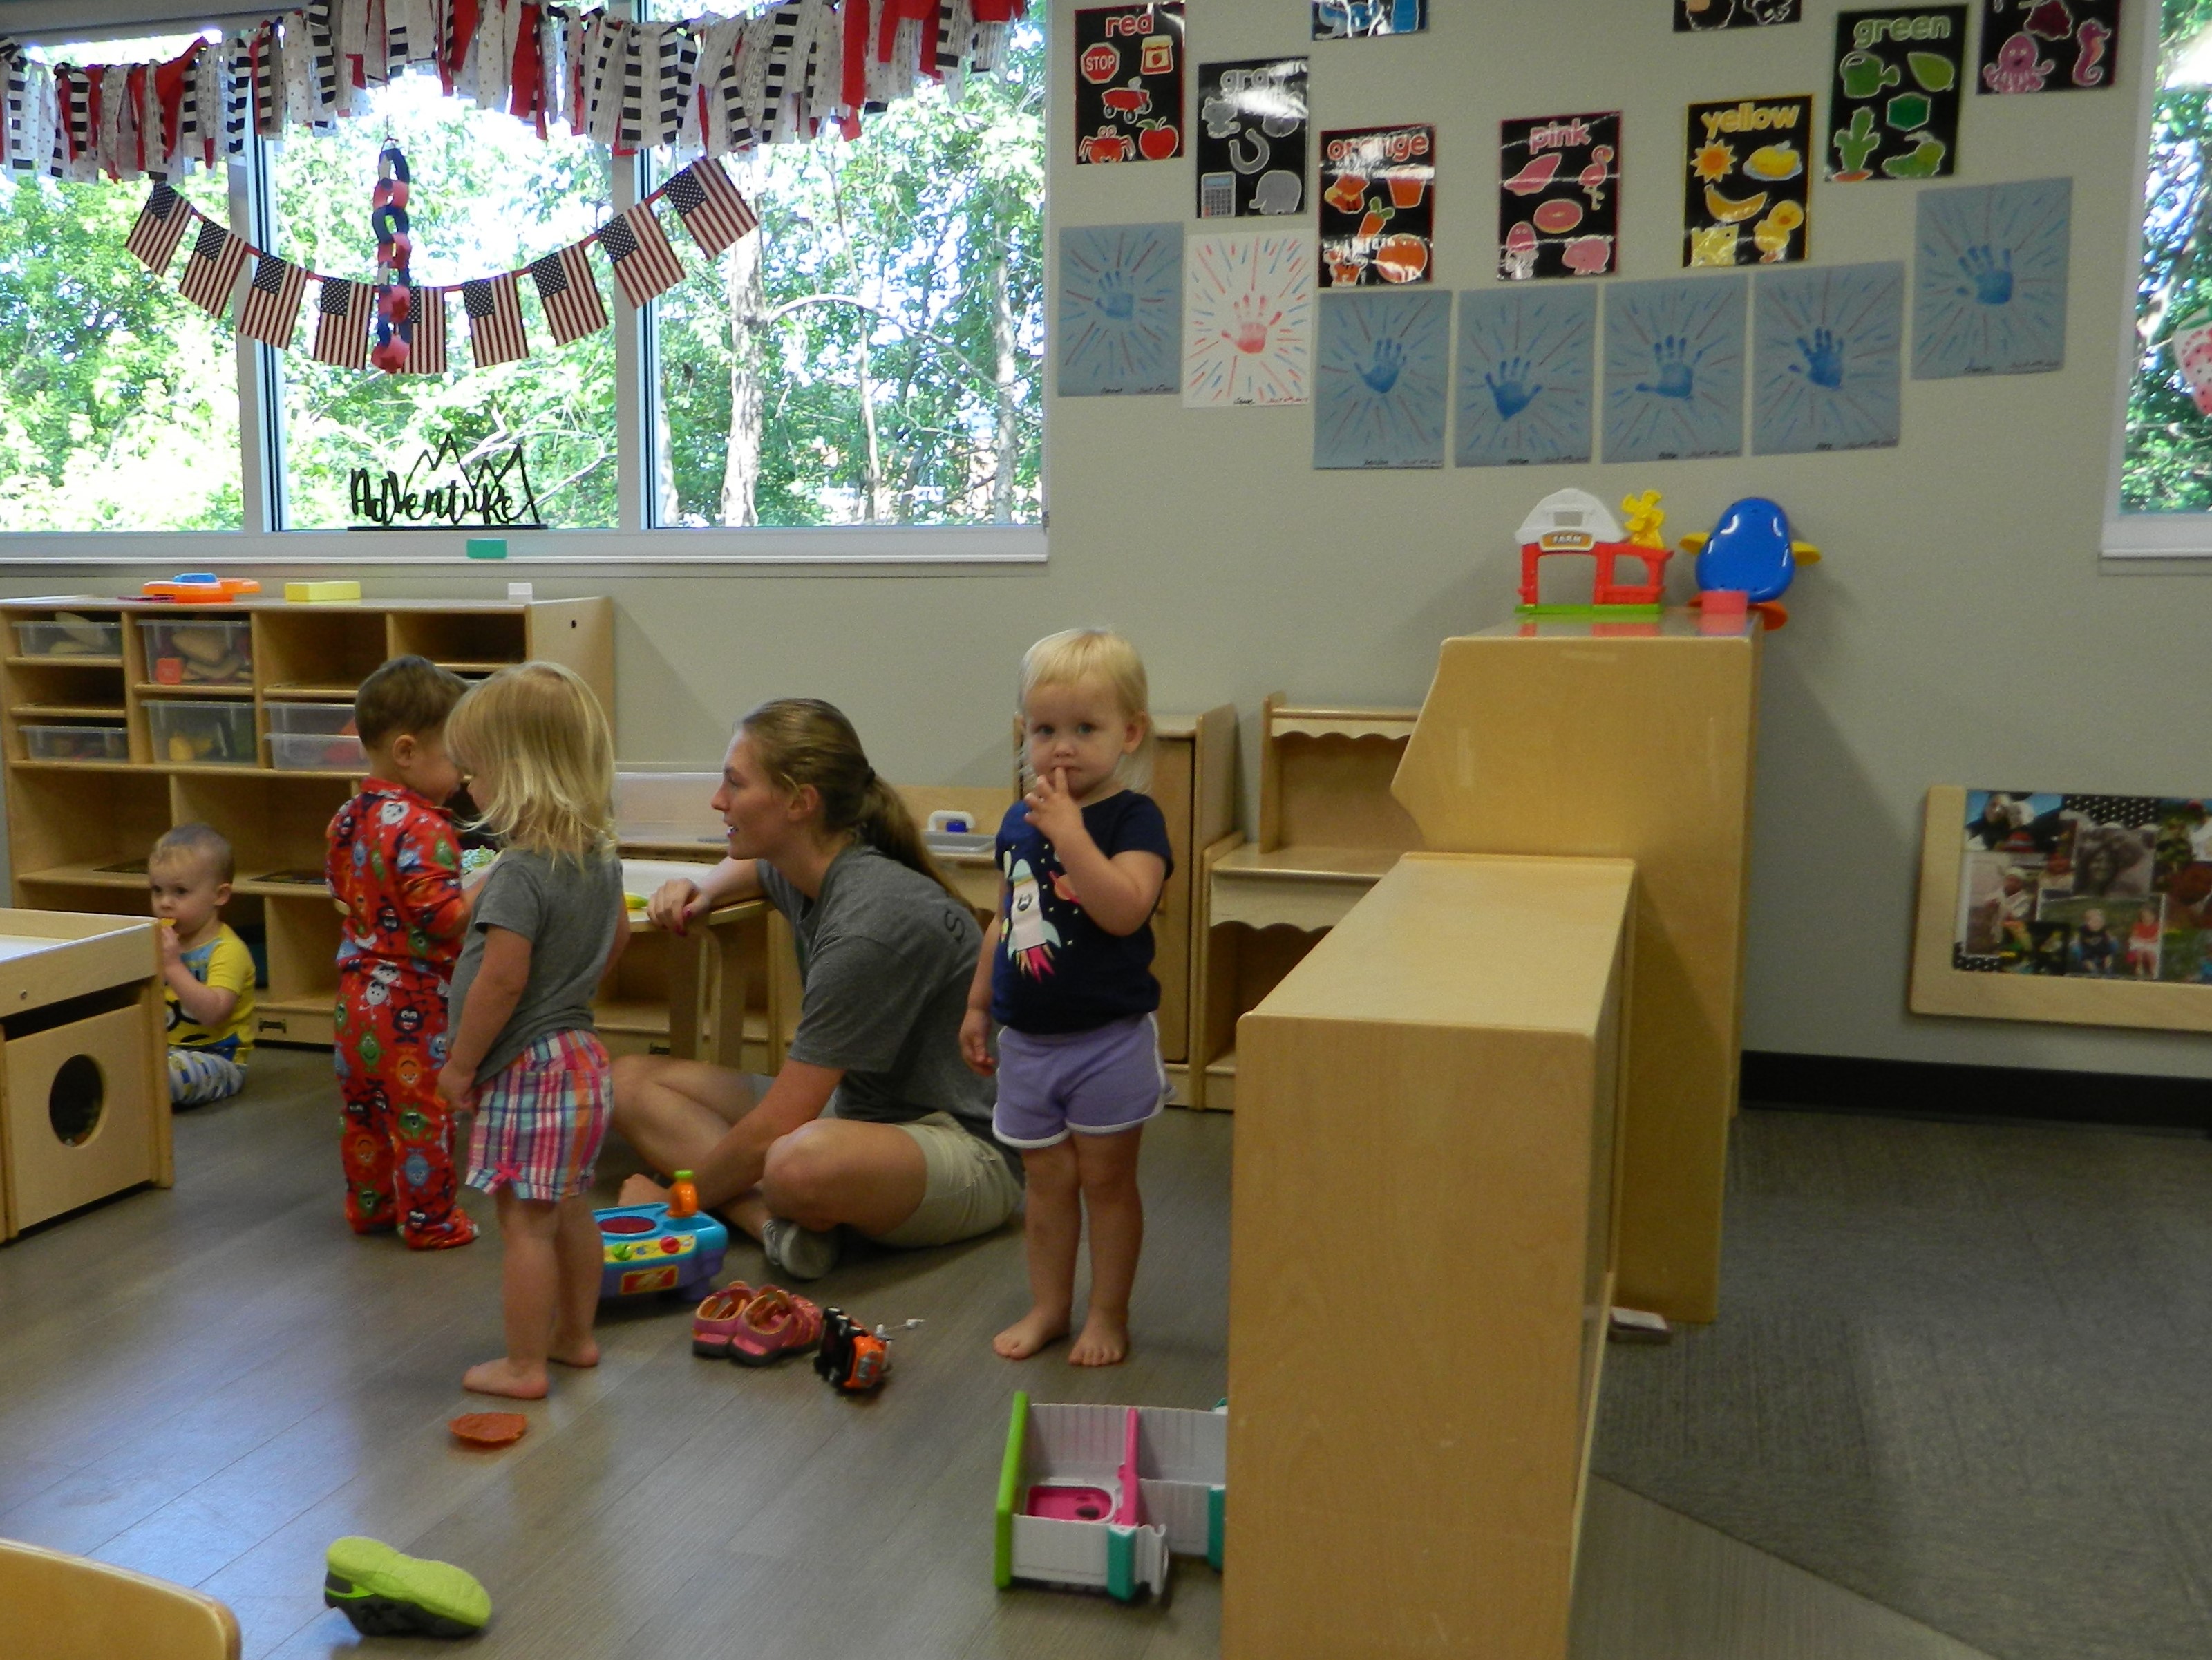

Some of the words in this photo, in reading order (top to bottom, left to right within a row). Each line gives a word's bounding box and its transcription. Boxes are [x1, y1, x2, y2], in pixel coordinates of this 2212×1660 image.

[1106, 6, 1154, 37] red
[1853, 16, 1951, 49] green
[1086, 55, 1115, 71] STOP
[1529, 117, 1592, 155] pink
[1701, 102, 1801, 140] yellow
